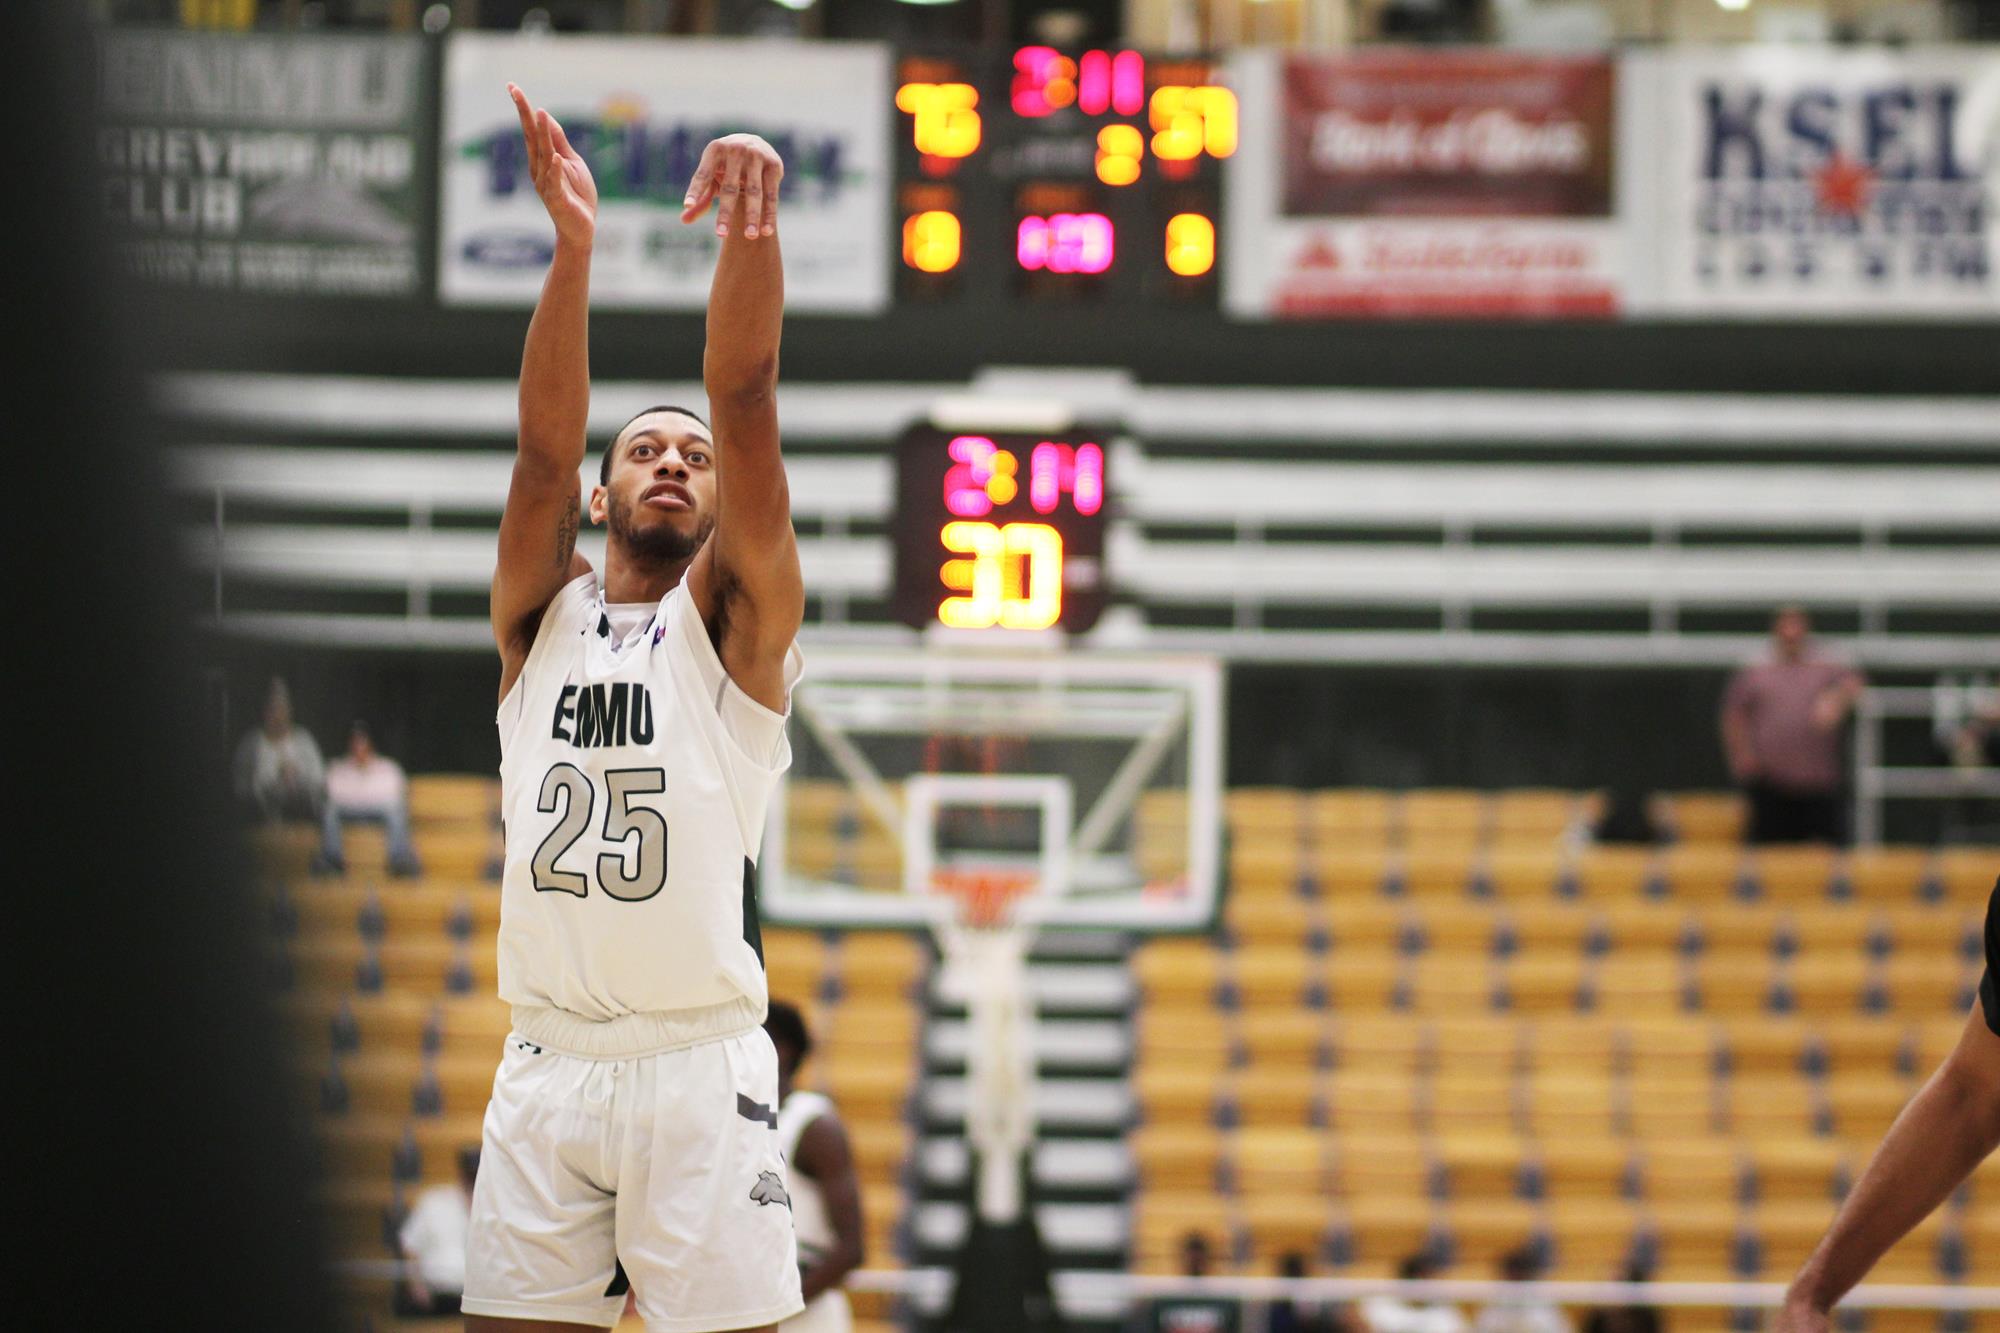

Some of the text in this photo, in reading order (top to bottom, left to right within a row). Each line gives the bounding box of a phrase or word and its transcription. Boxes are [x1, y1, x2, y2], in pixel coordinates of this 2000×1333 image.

[938, 521, 1064, 630] 30
[552, 682, 655, 749] ENMU
[530, 761, 668, 902] 25
